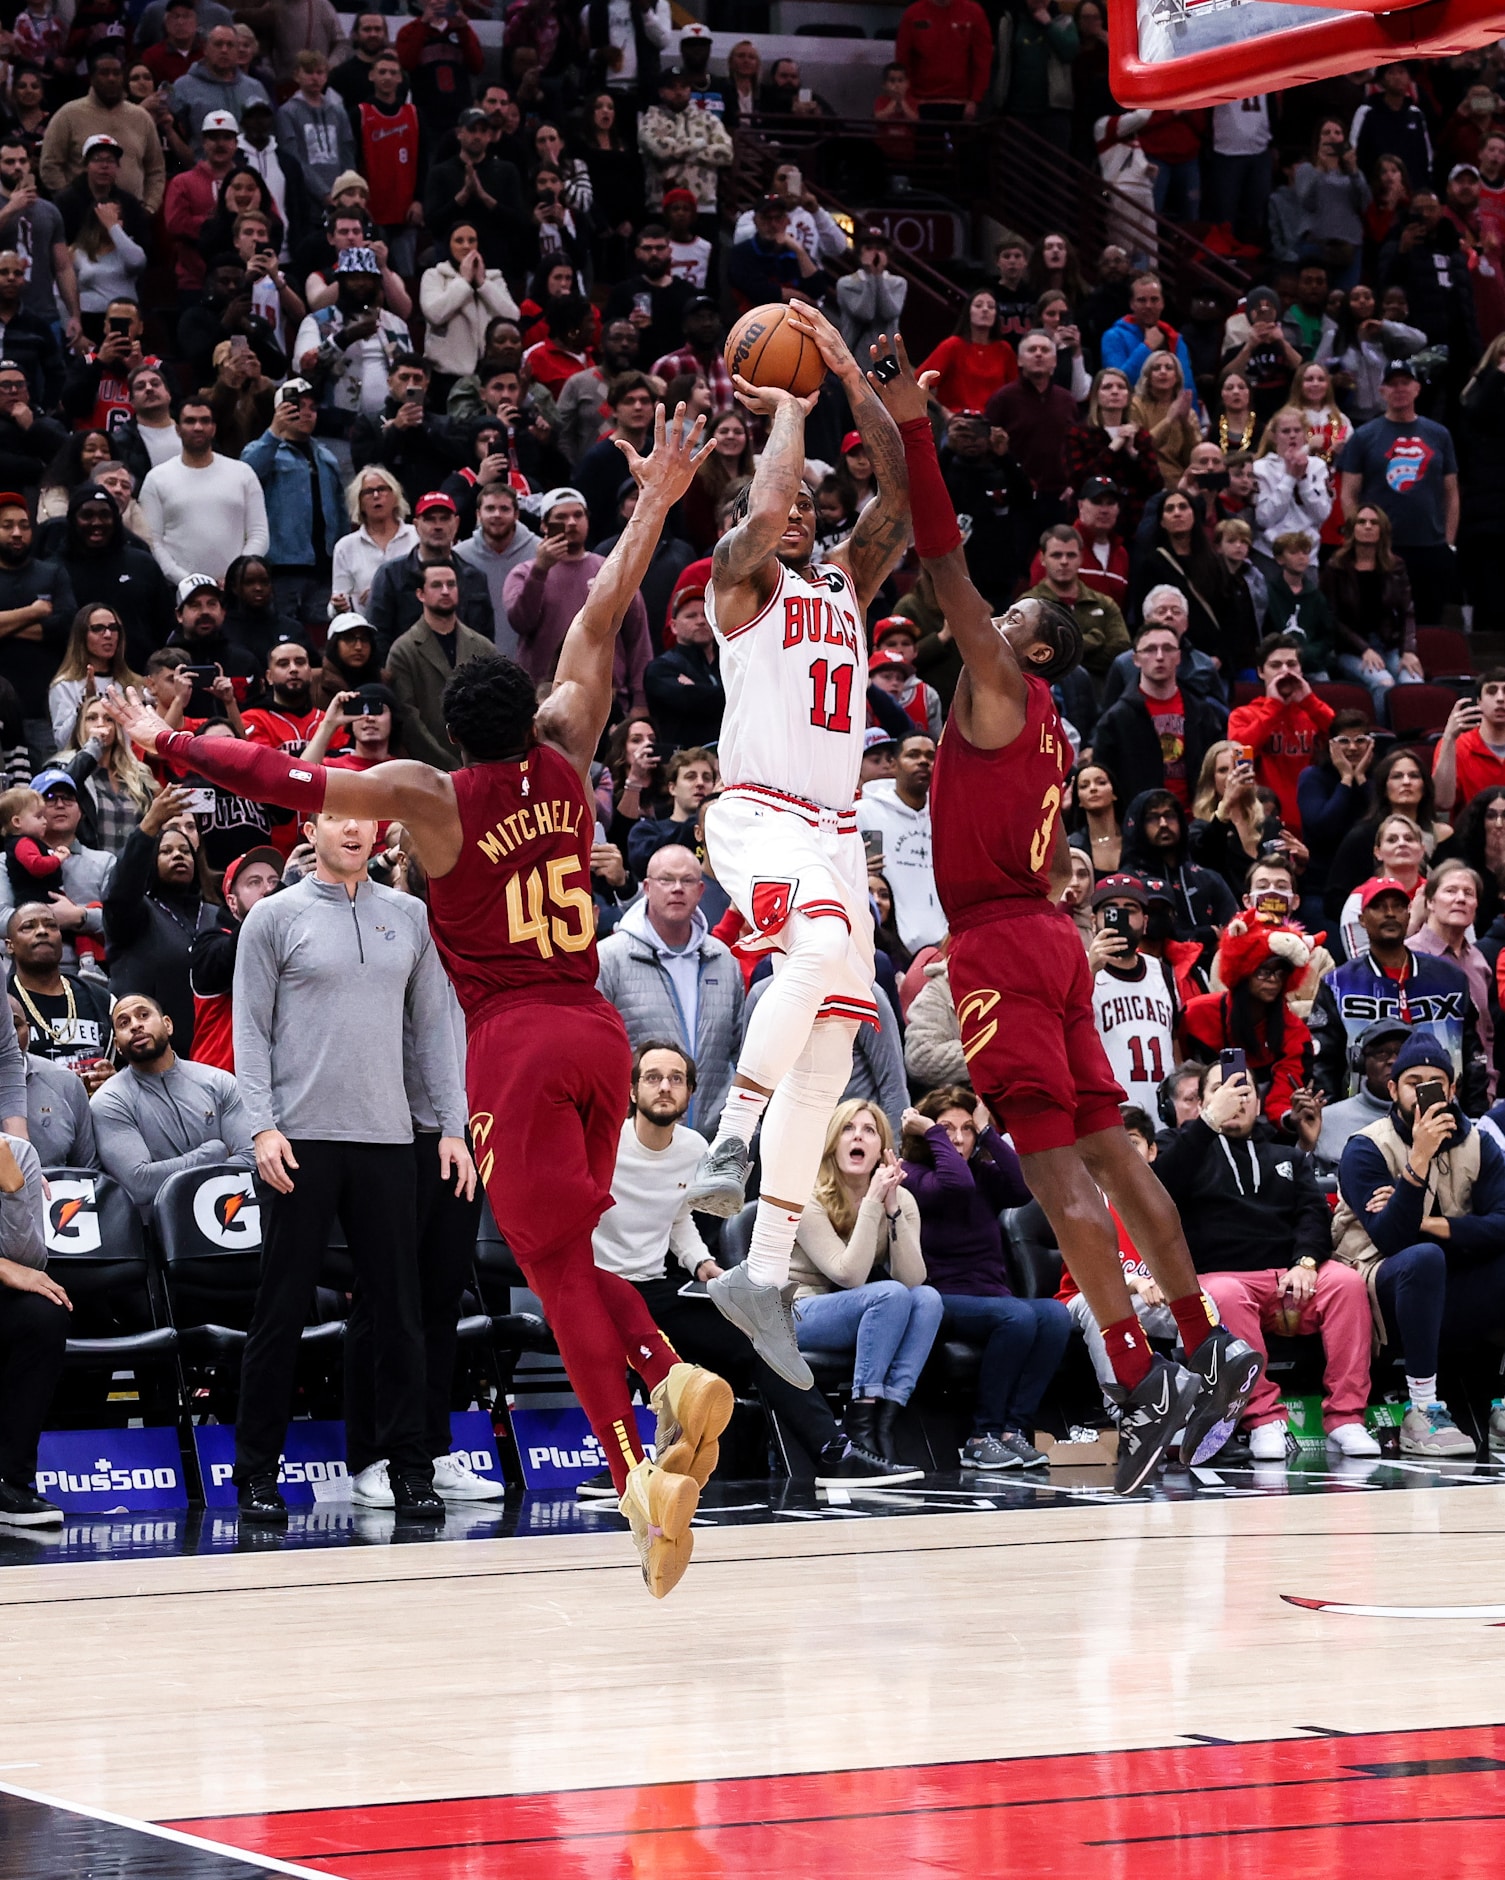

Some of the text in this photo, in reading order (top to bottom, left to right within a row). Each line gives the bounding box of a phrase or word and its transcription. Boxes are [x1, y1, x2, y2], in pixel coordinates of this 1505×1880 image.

[883, 216, 934, 253] 101
[732, 322, 768, 375] Wilso
[809, 657, 854, 734] 11
[477, 800, 584, 864] MITCHELL
[1030, 784, 1060, 873] 3
[505, 854, 595, 959] 45
[1101, 995, 1172, 1033] CHICAG
[1341, 992, 1464, 1024] SOX
[1127, 1035, 1165, 1082] 11
[36, 1464, 177, 1494] Plus500
